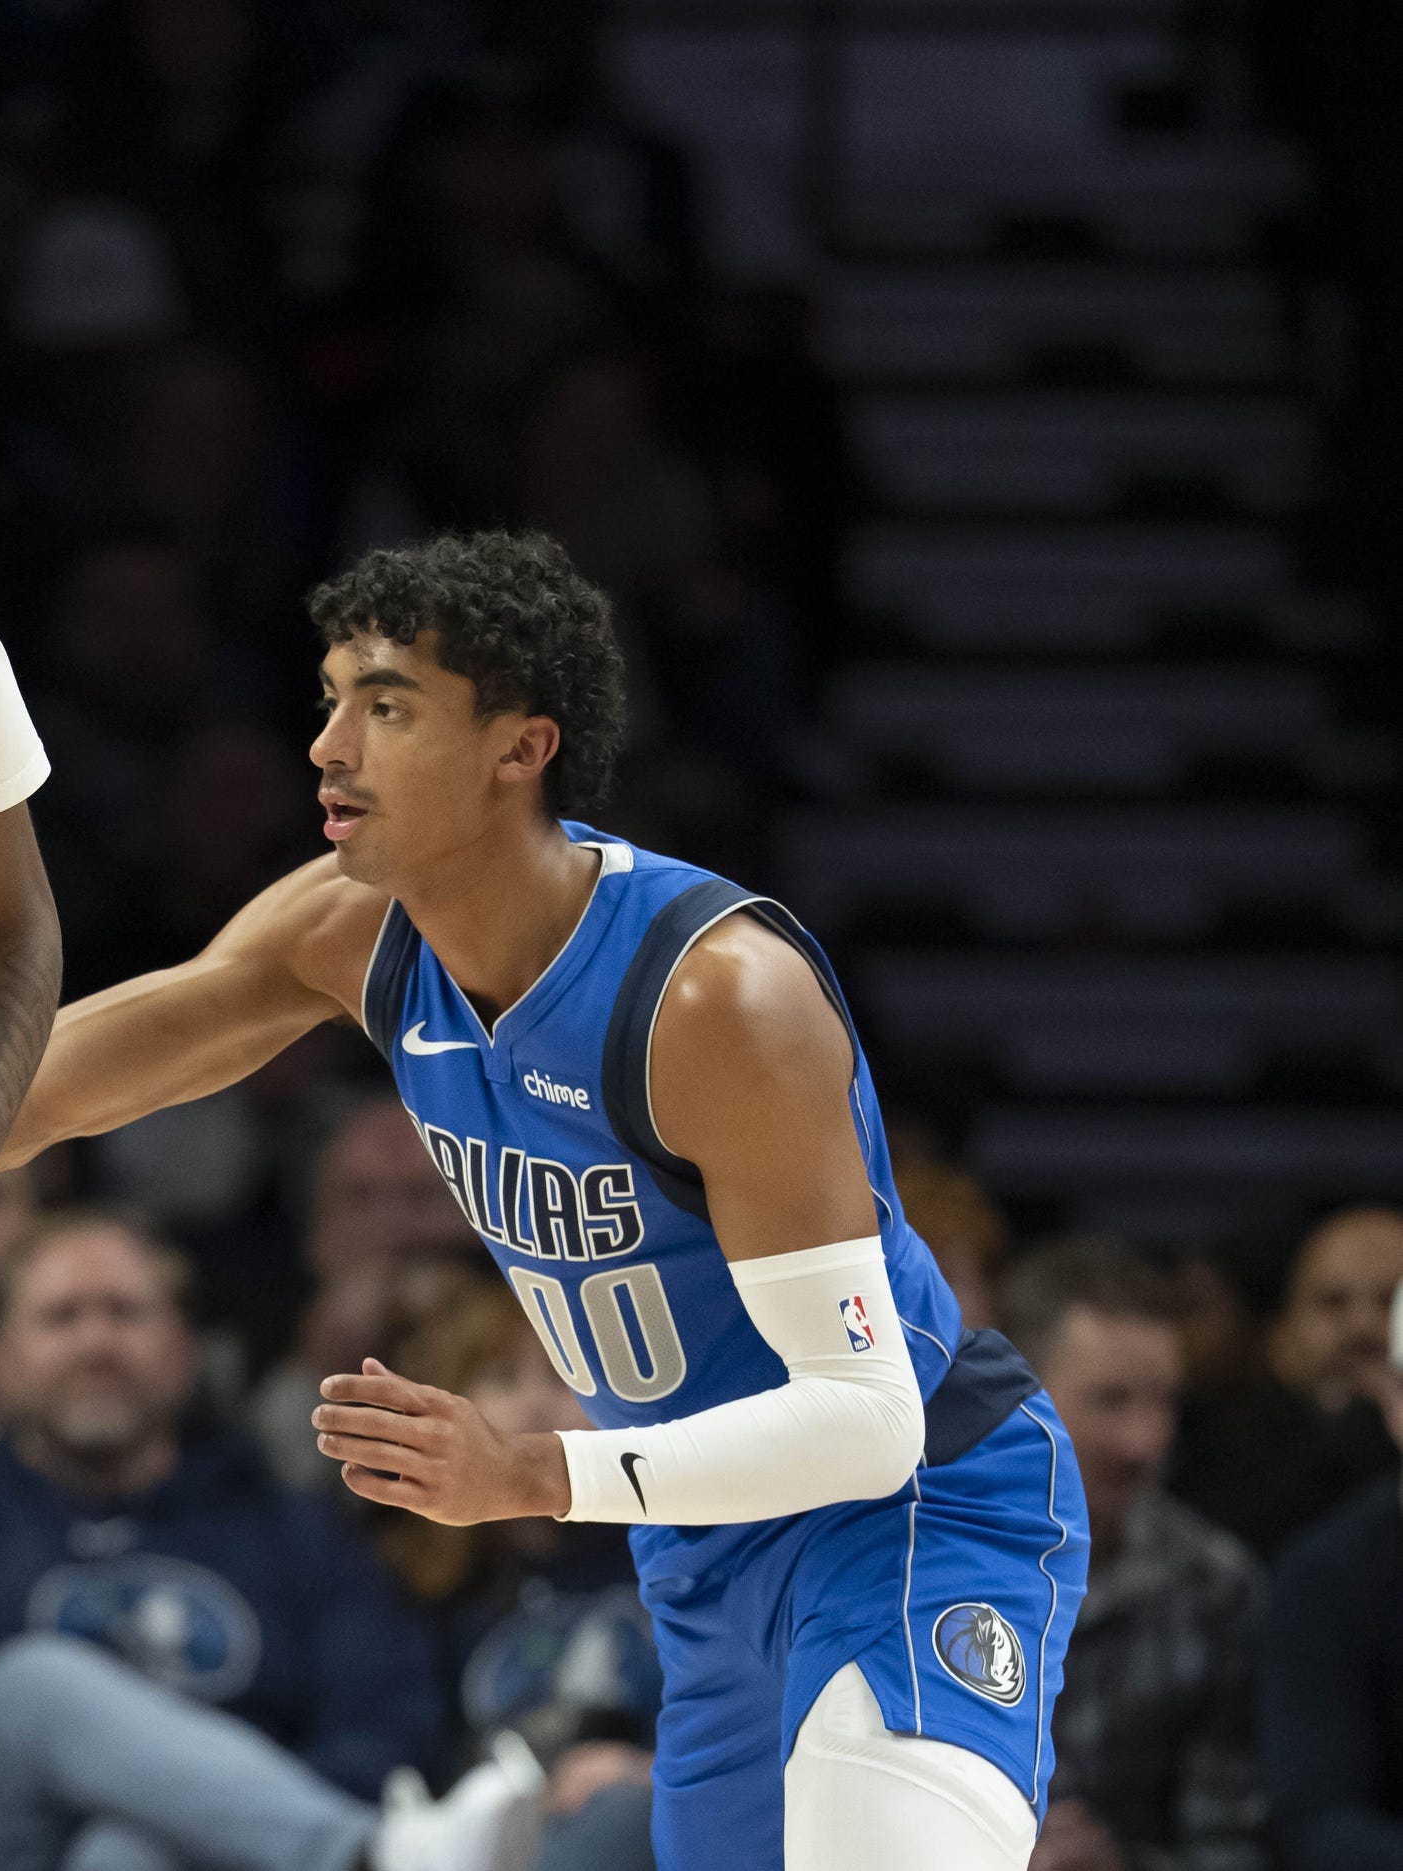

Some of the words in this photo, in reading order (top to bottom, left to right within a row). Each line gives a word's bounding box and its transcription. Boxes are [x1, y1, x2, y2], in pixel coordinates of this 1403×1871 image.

[523, 1069, 591, 1111] chime
[410, 1110, 645, 1262] ALLAS
[508, 1263, 687, 1404] 00
